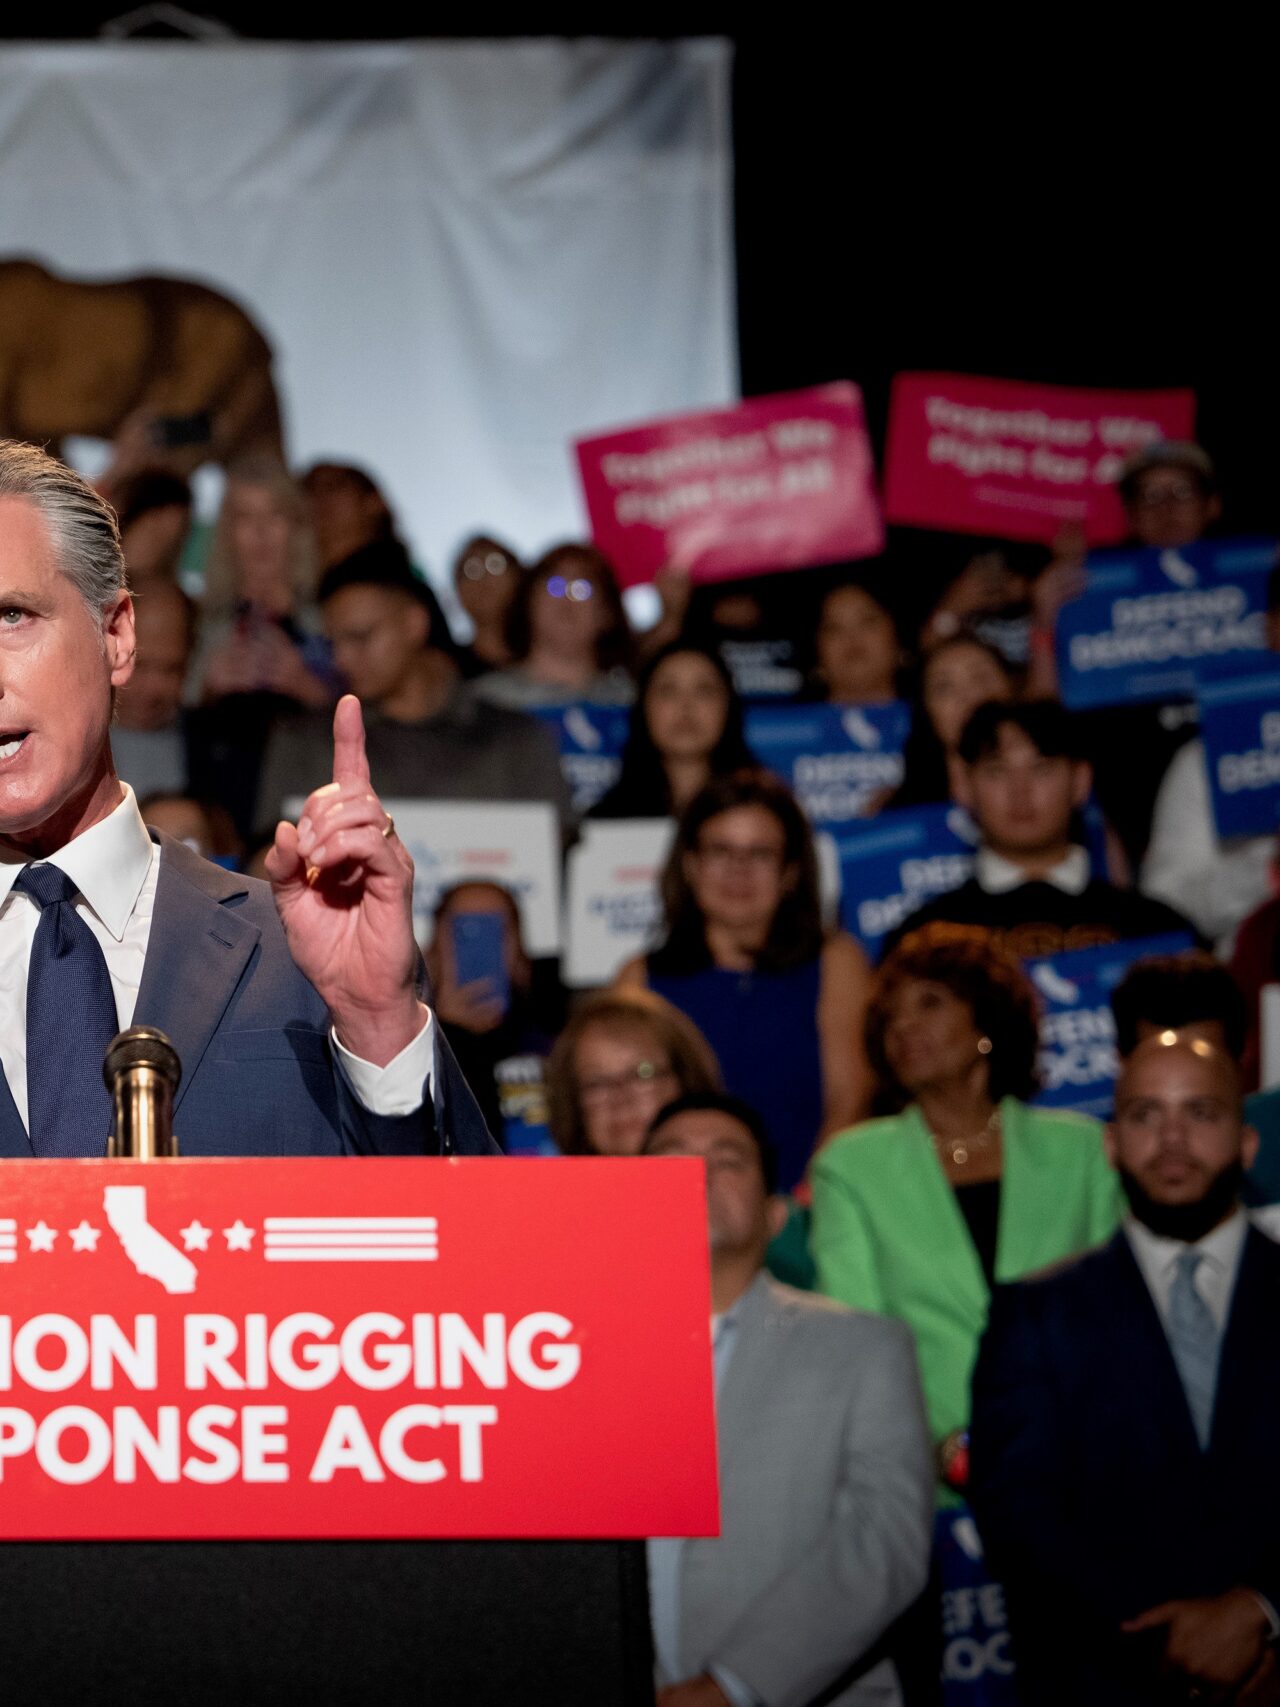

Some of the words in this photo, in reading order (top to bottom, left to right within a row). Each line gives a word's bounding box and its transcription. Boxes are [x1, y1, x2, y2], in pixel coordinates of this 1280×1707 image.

[1070, 611, 1266, 672] DEMOCRAC
[1112, 585, 1248, 630] DEFEND
[183, 1311, 581, 1391] RIGGING
[309, 1403, 498, 1482] ACT
